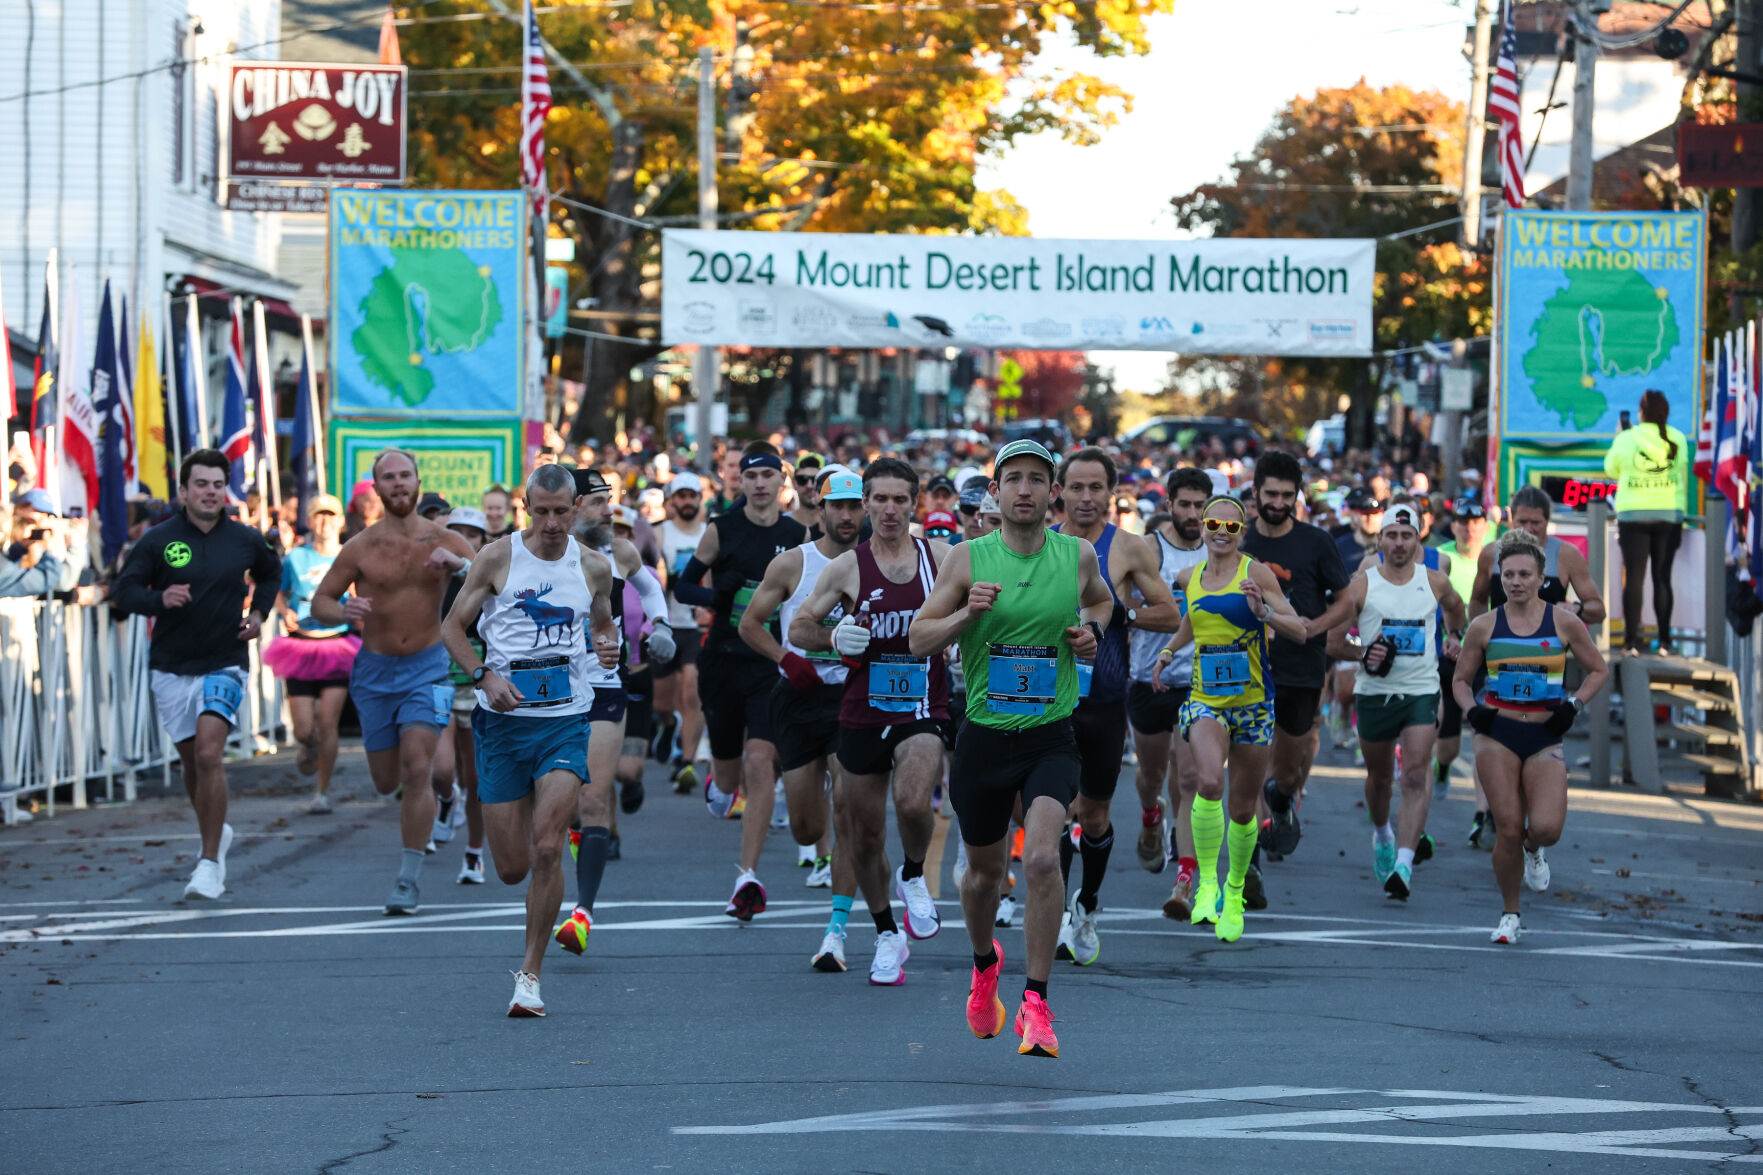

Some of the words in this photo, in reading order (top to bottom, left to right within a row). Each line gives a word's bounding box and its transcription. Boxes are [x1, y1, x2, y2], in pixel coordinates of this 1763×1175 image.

[233, 69, 331, 121] CHINA
[336, 71, 398, 126] JOY
[341, 198, 514, 228] WELCOME
[340, 228, 515, 249] MARATHONERS
[1515, 219, 1694, 248] WELCOME
[1513, 249, 1693, 271] MARATHONERS
[687, 250, 776, 285] 2024
[796, 250, 910, 290] Mount
[927, 252, 1040, 291] Desert
[1057, 254, 1154, 292] Island
[1170, 254, 1348, 293] Marathon
[1014, 664, 1035, 672] Matt
[1215, 666, 1232, 680] F1
[537, 683, 548, 698] 4
[888, 678, 910, 694] 10
[1016, 674, 1029, 693] 3
[1513, 684, 1531, 697] F4
